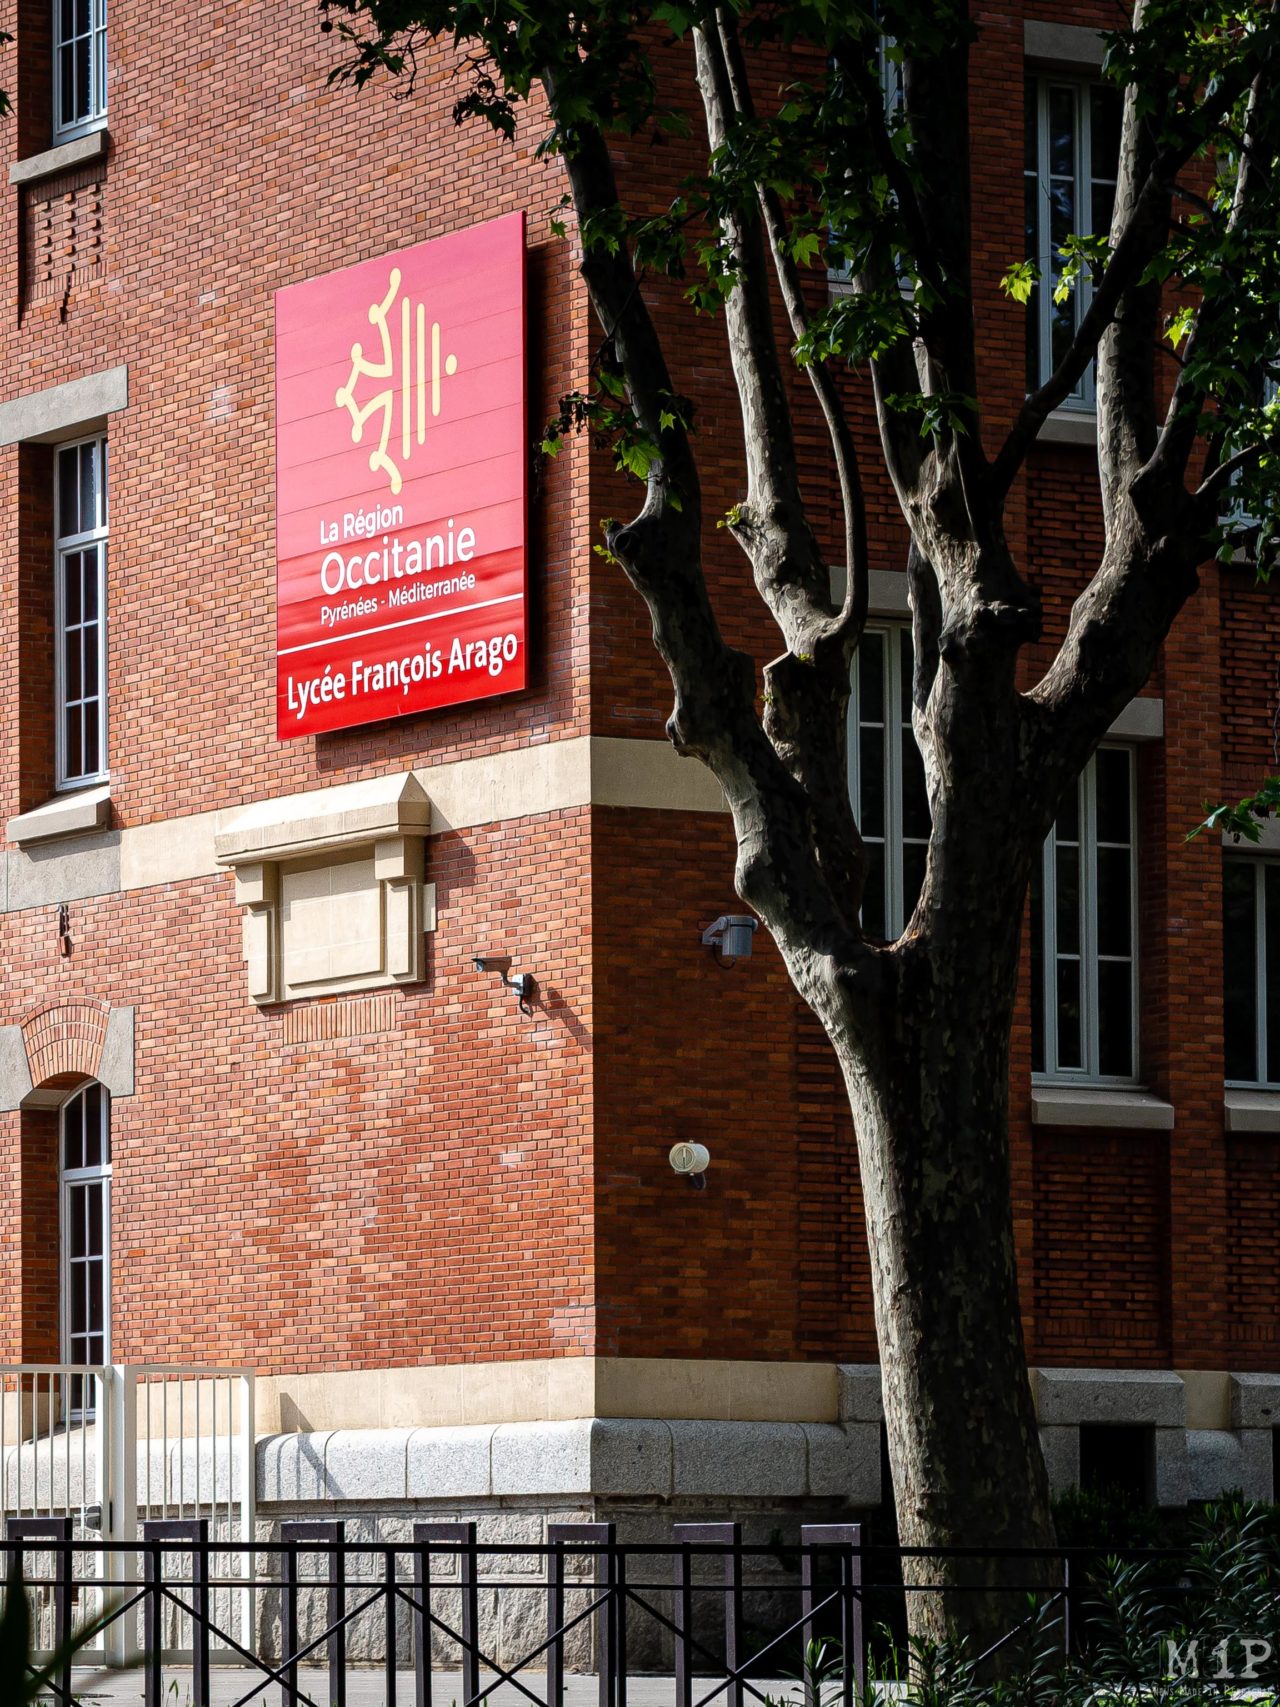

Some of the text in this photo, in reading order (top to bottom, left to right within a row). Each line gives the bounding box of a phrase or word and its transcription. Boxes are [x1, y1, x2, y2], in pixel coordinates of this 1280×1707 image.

[320, 504, 403, 544] La Région
[320, 519, 476, 595] Occitanie
[321, 596, 378, 627] Pyrénées
[388, 571, 476, 608] Méditerranée
[287, 633, 518, 720] Lycée François Arago
